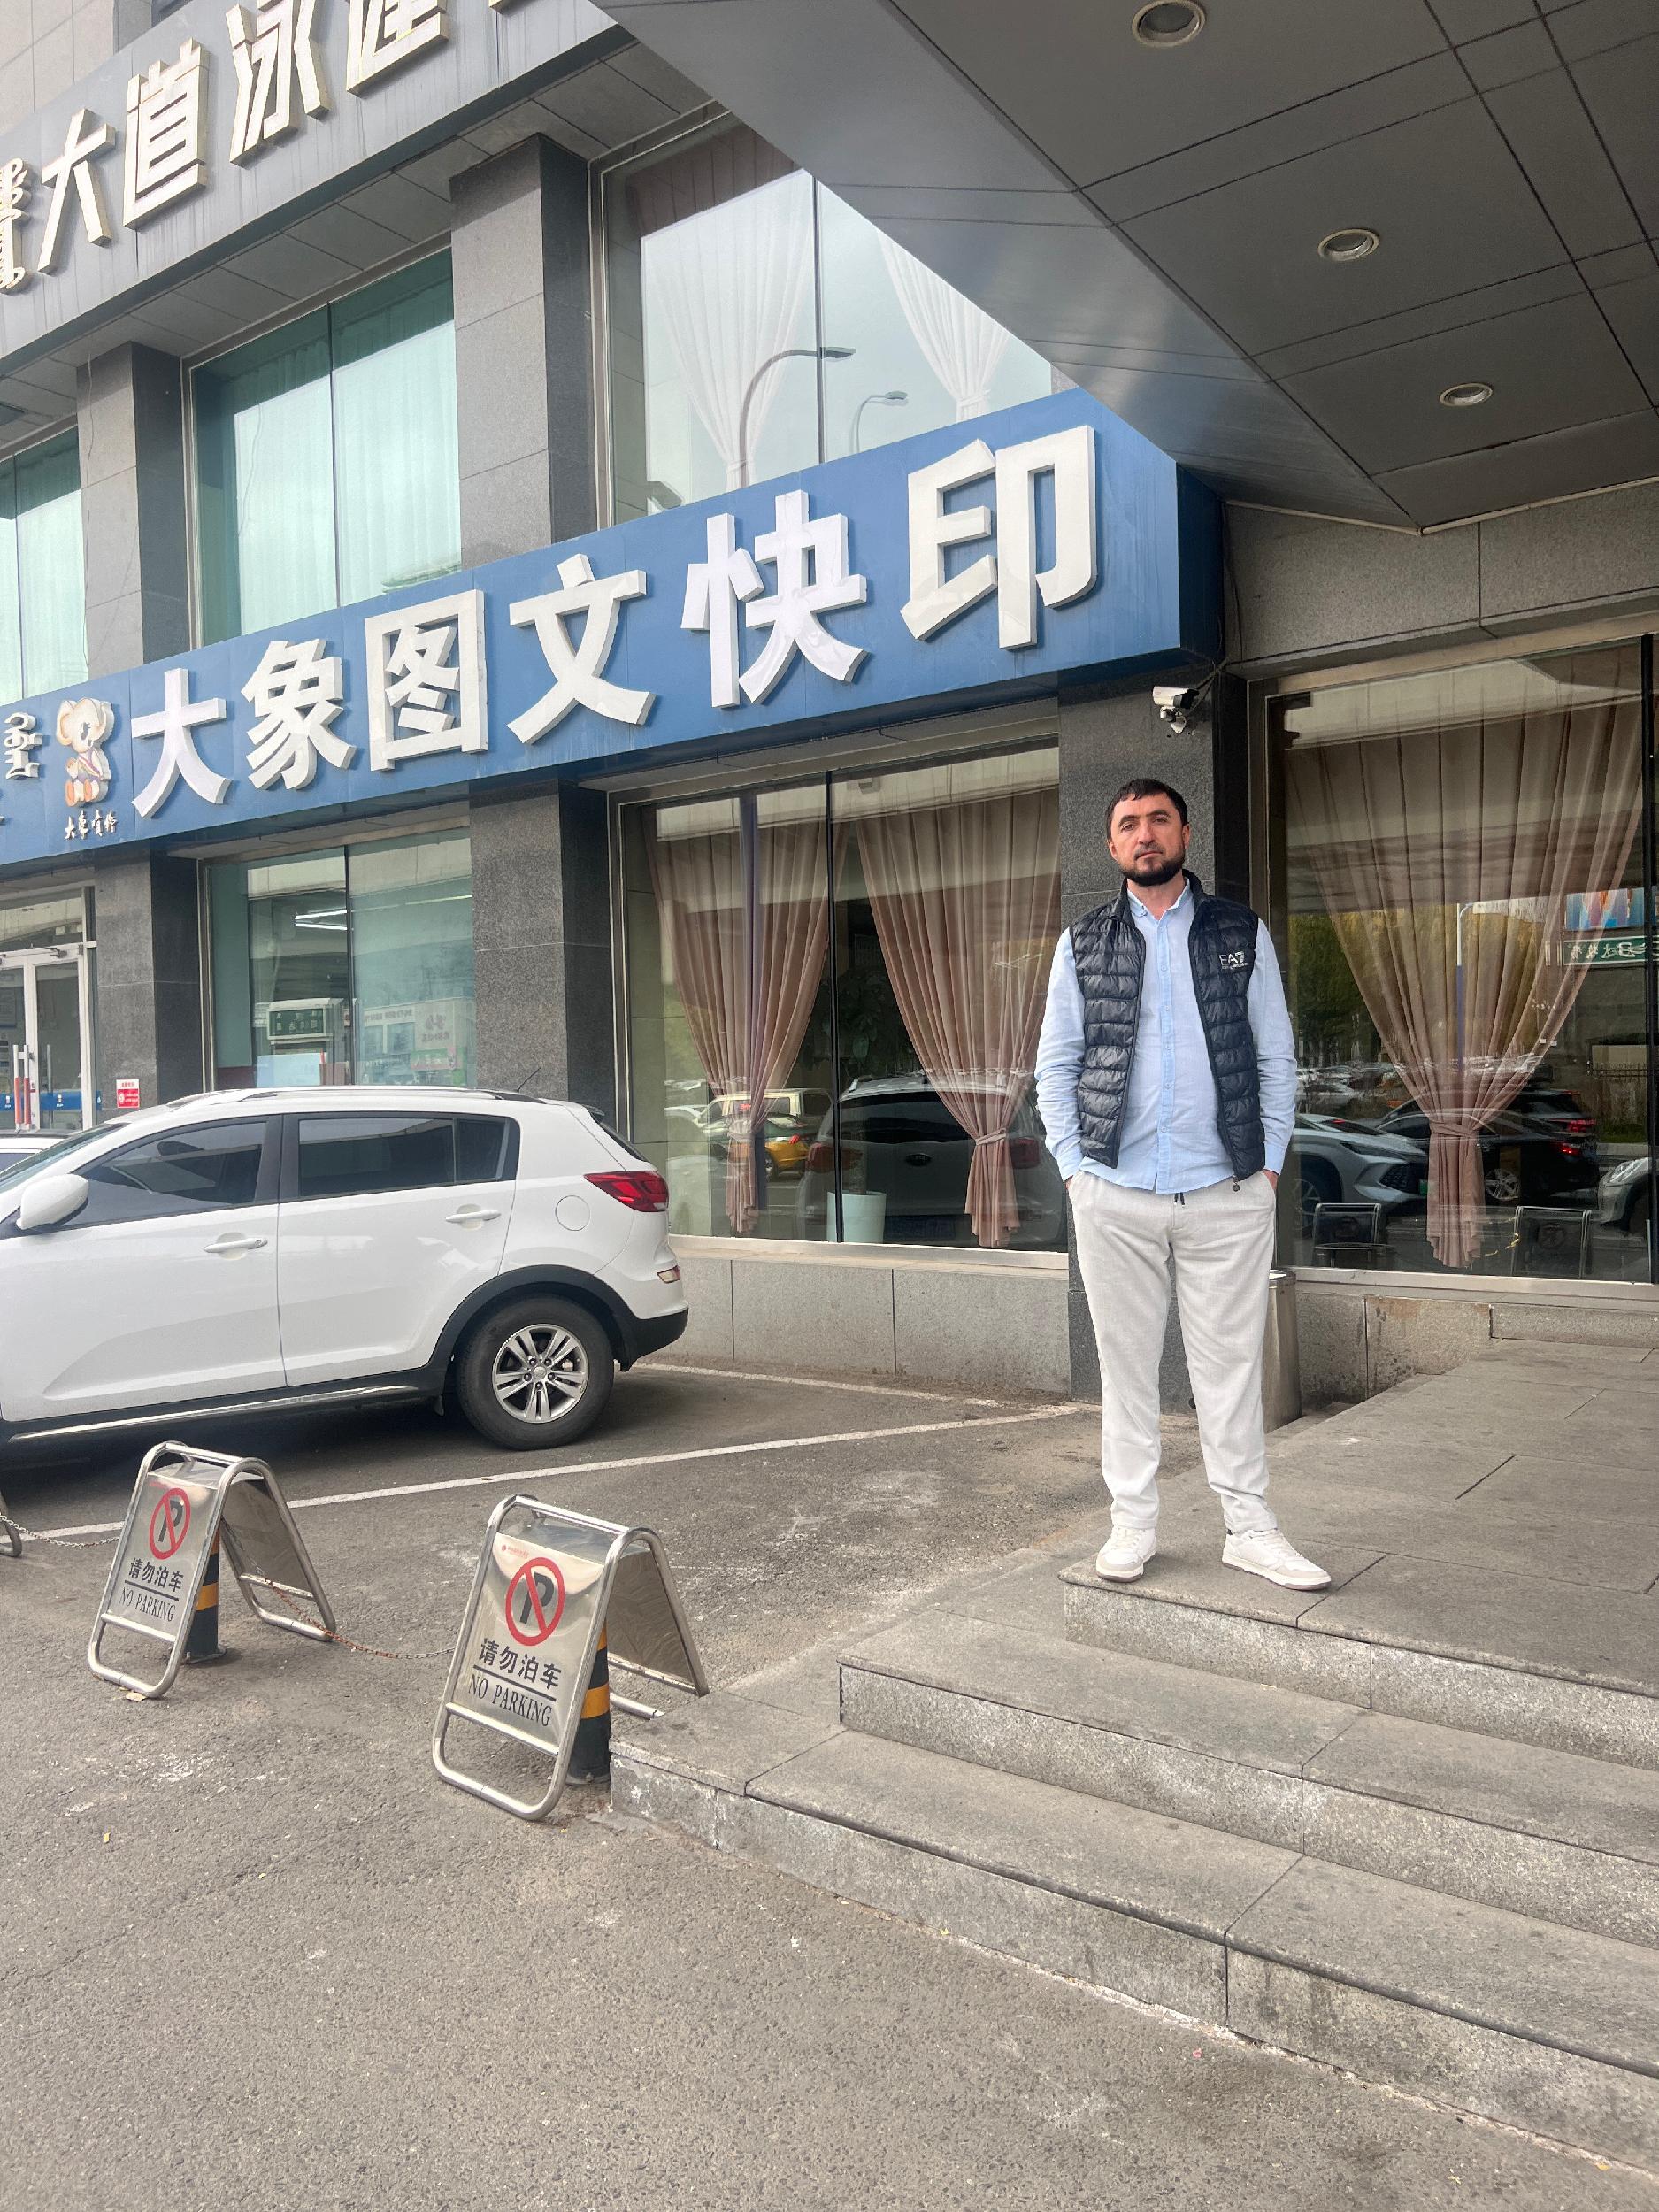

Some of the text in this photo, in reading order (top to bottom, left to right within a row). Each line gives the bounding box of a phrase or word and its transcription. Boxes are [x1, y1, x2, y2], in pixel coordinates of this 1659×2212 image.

[132, 425, 1096, 819] 大象图文快印
[1218, 951, 1245, 966] EA7
[128, 1557, 185, 1593] 请勿泊车
[119, 1587, 176, 1623] NO PARKING
[478, 1638, 562, 1691] 请勿泊车
[468, 1673, 554, 1727] NO PARKING
